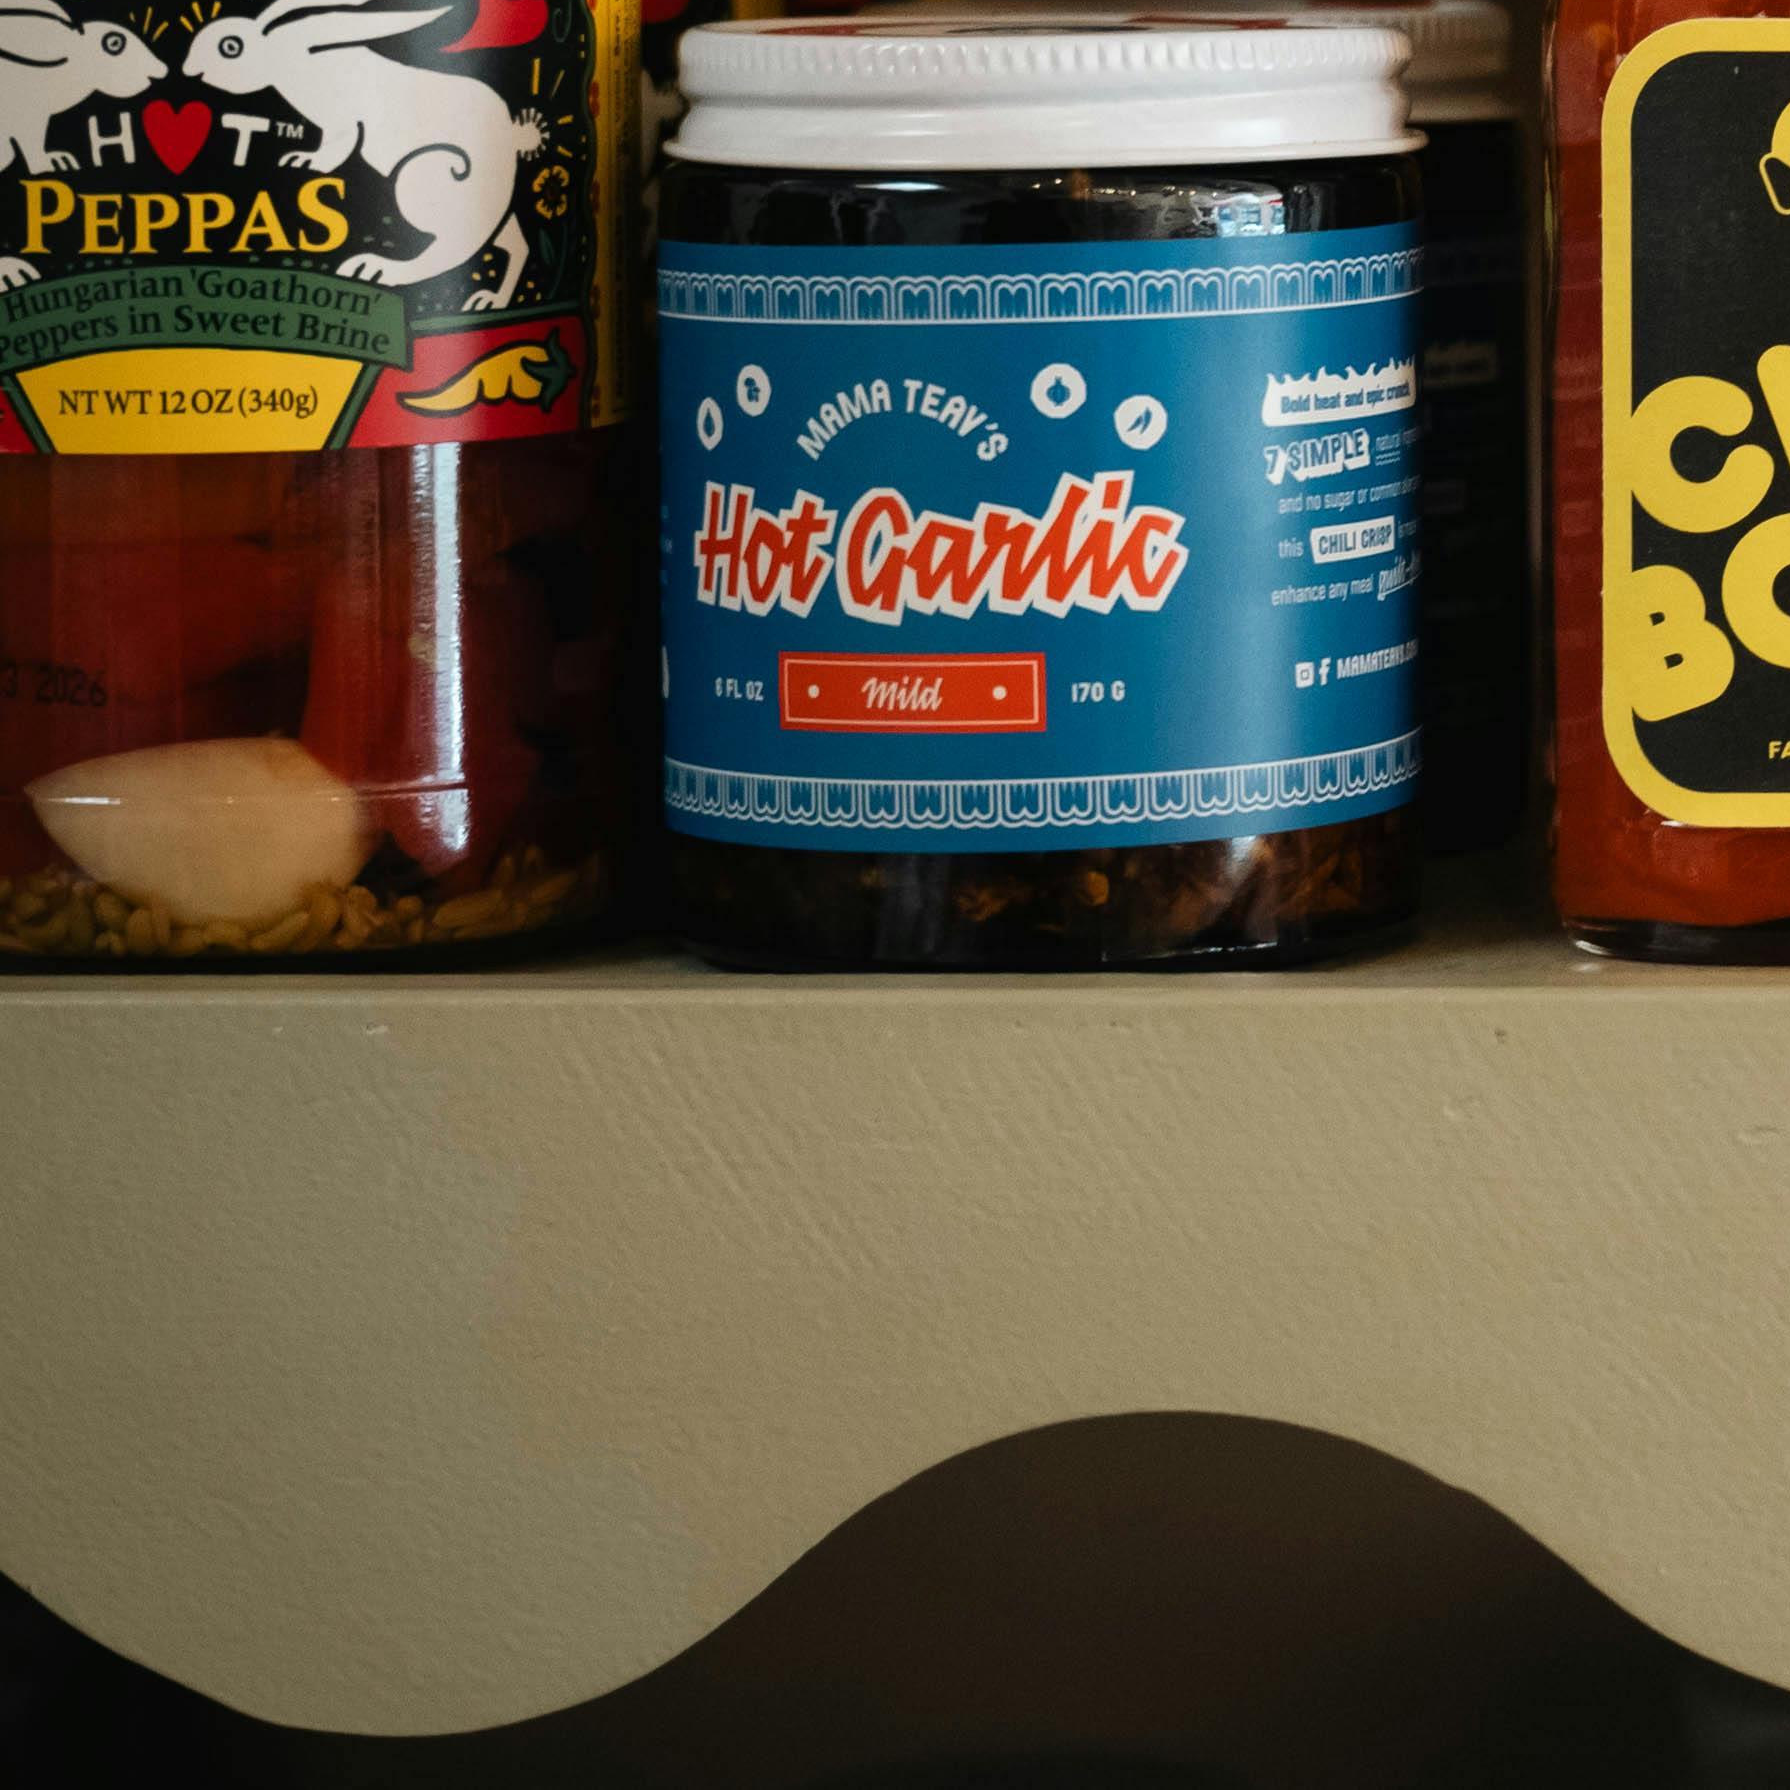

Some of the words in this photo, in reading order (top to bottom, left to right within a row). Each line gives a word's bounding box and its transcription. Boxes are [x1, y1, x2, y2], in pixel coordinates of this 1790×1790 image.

[20, 177, 348, 255] PEPPAS
[3, 271, 184, 324] Hungarian
[128, 306, 162, 334] in
[173, 304, 284, 339] Sweet
[295, 312, 391, 356] Brine
[58, 389, 100, 415] NT
[103, 389, 153, 415] WT
[160, 390, 187, 415] 12
[190, 390, 236, 416] OZ
[237, 386, 319, 420] (340g)
[796, 378, 893, 461] MAMA
[1286, 429, 1369, 475] SIMPLE
[1279, 493, 1303, 514] and
[1306, 493, 1321, 510] no
[1324, 489, 1355, 511] sugar
[1357, 488, 1368, 504] or
[694, 480, 839, 619] Hot
[836, 469, 1190, 627] Garlic
[1279, 537, 1304, 558] this
[1319, 532, 1357, 555] CHILI
[1360, 524, 1392, 549] CRISP
[1271, 584, 1326, 606] enhance
[1328, 580, 1348, 601] any
[726, 679, 742, 699] FL
[745, 679, 764, 702] OZ
[860, 676, 943, 711] Mild
[1071, 681, 1104, 703] 170
[1111, 682, 1126, 702] G
